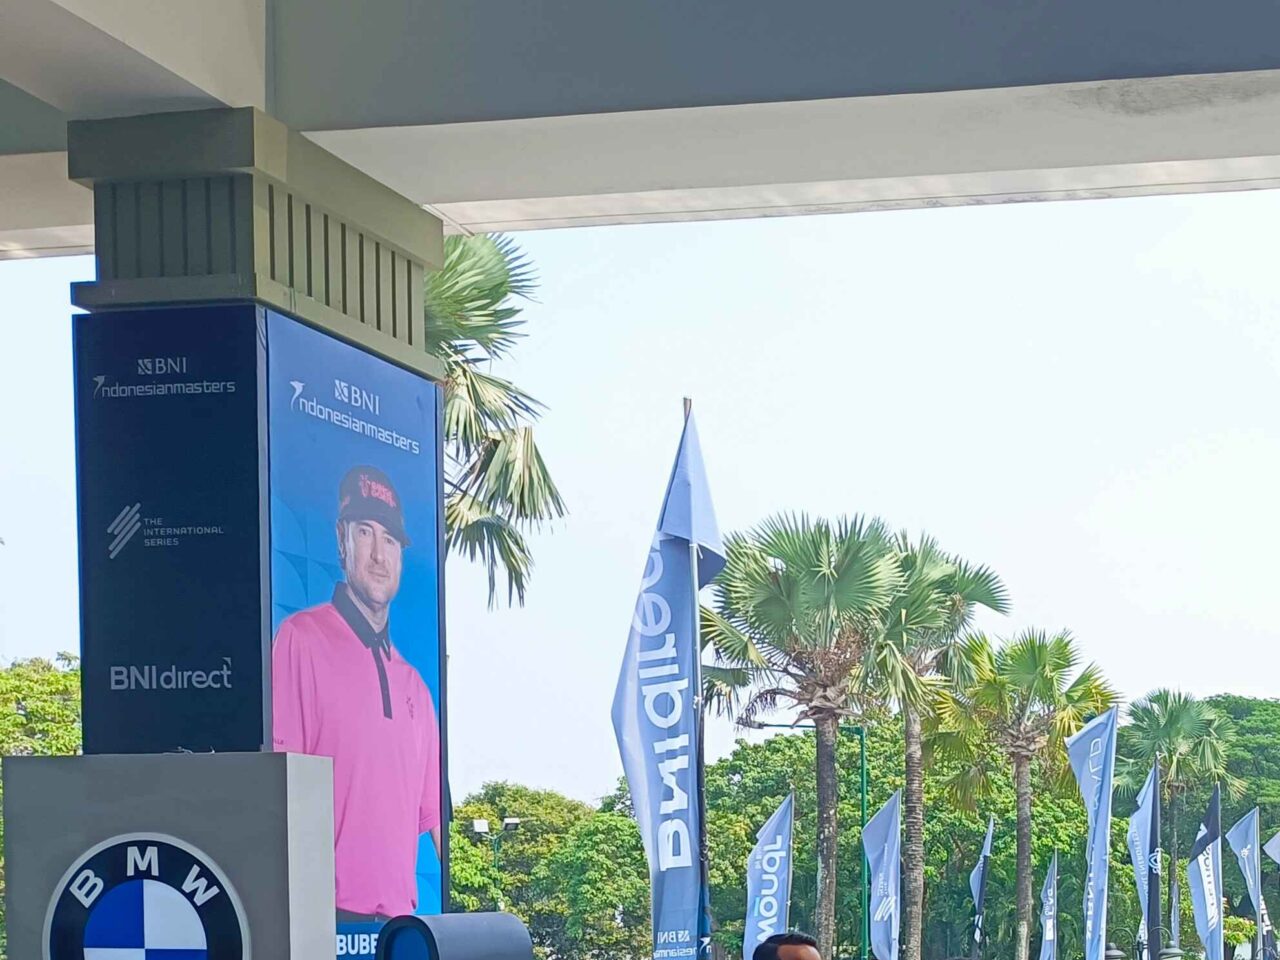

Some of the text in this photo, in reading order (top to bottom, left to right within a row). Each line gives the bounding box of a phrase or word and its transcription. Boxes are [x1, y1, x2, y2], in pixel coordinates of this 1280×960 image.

[155, 357, 187, 374] BNI
[351, 386, 380, 415] BNI
[143, 517, 163, 526] THE
[143, 526, 224, 536] INTERNATIONAL
[144, 537, 180, 547] SERIES
[69, 845, 221, 908] BMW
